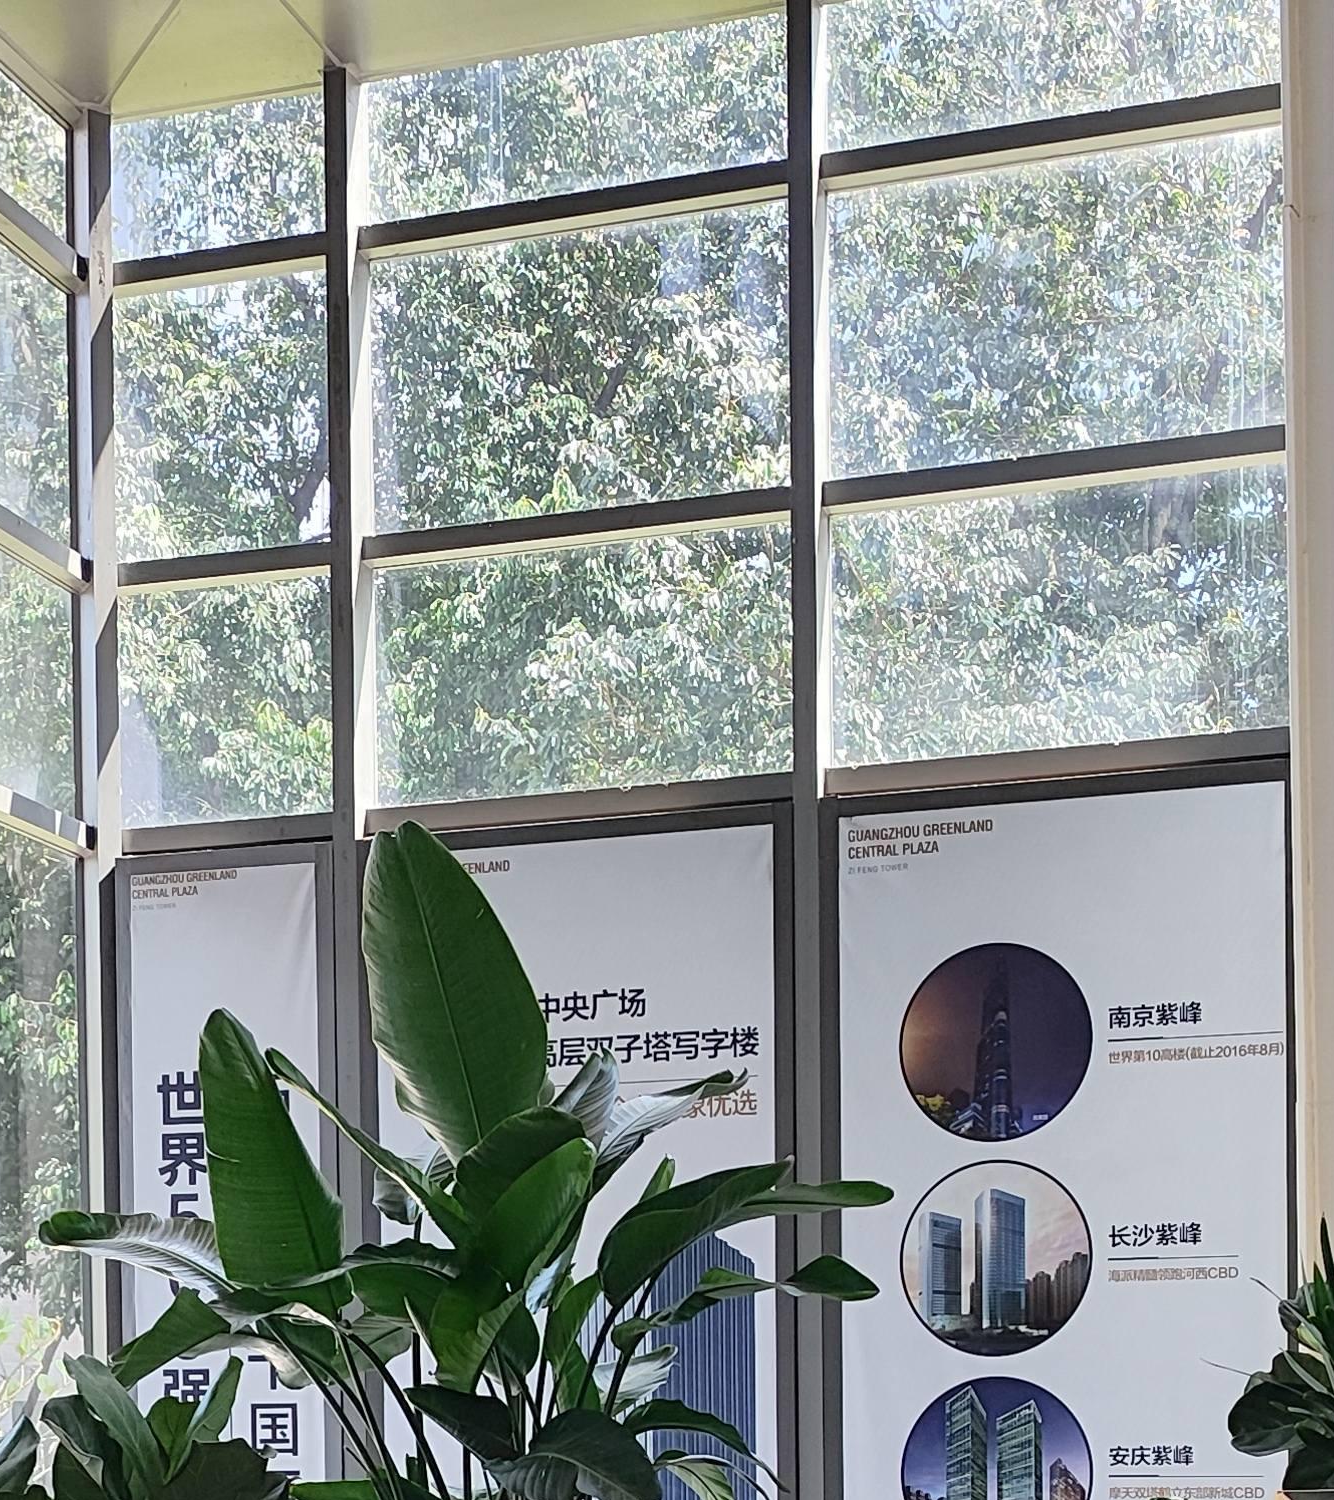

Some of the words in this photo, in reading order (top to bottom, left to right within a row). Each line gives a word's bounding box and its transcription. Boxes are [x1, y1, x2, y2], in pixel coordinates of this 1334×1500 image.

[848, 825, 920, 842] GUANGZHOU
[923, 819, 993, 837] GREENLAND
[848, 844, 899, 859] CENTRAL
[902, 840, 939, 855] PLAZA
[132, 873, 184, 886] GUANGZHOU
[186, 869, 237, 882] GREENLAND
[132, 887, 169, 899] CENTRAL
[171, 886, 198, 897] PLAZA
[538, 988, 646, 1023] 中央广场
[1108, 1001, 1202, 1029] 南京紫峰
[1108, 1221, 1202, 1248] 长沙紫峰
[1109, 1445, 1194, 1466] 安庆紫峰
